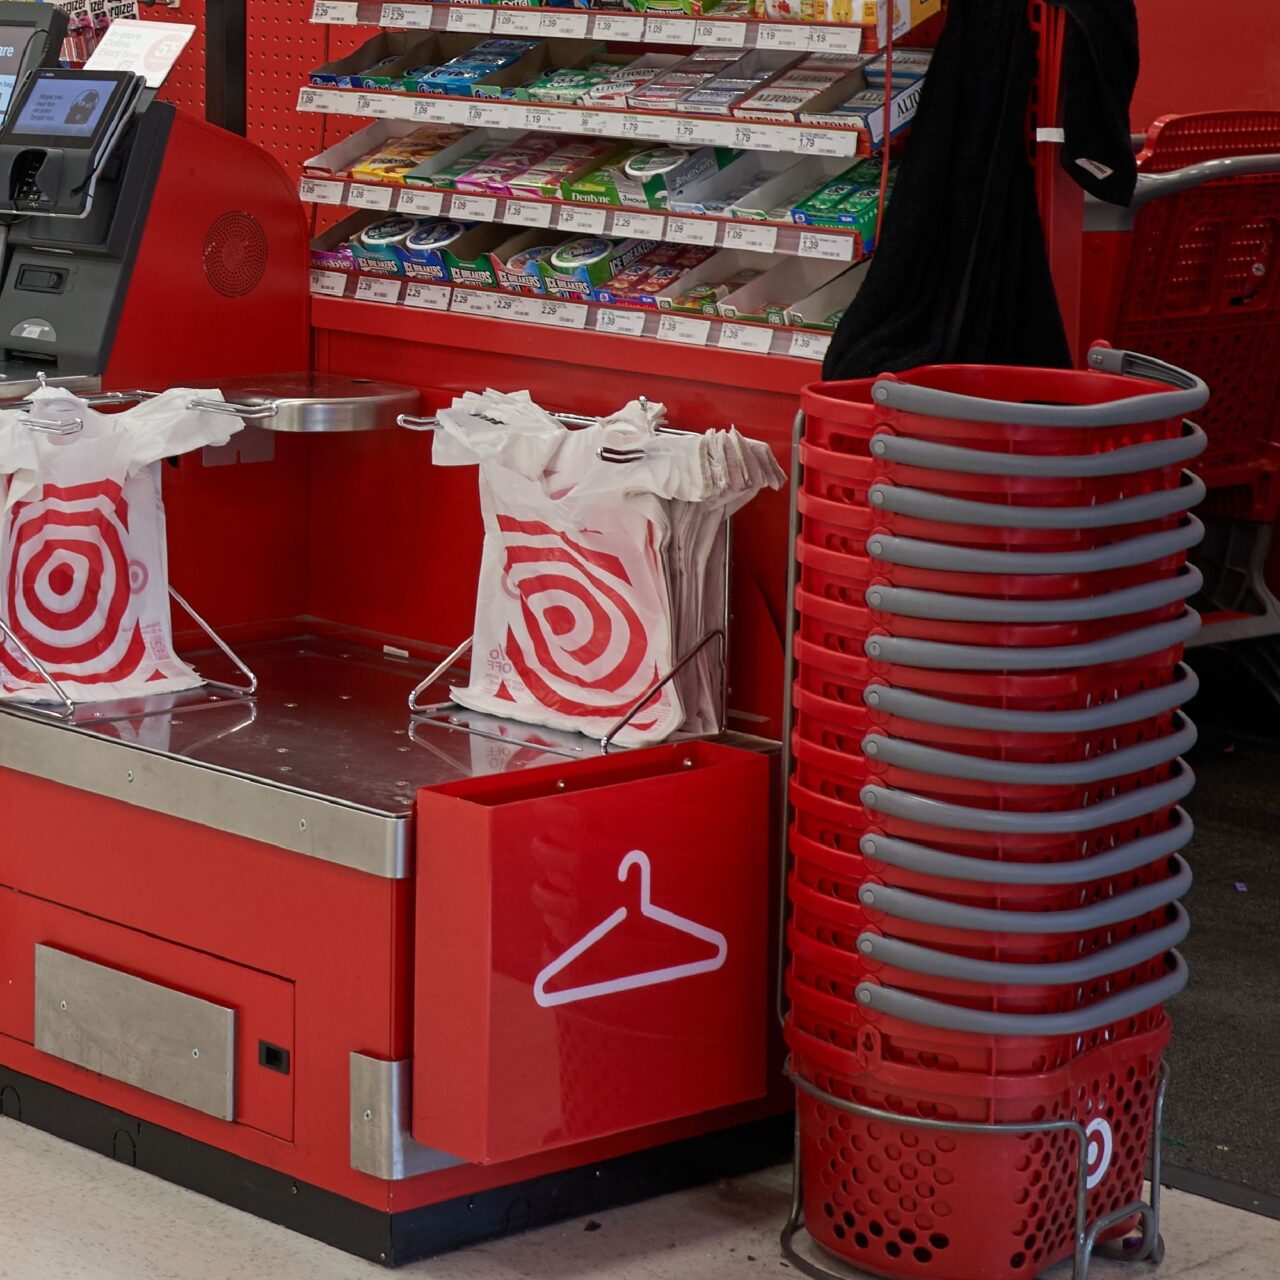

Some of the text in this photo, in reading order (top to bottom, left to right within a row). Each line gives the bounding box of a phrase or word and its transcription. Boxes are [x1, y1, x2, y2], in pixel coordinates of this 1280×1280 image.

[315, 8, 328, 17] 2.29
[390, 12, 404, 21] 2.29
[648, 24, 663, 34] 1.09
[696, 26, 713, 37] 1.09
[760, 31, 775, 40] 1.19
[301, 95, 314, 105] 1.09
[752, 93, 806, 104] ALTOIDS
[357, 100, 370, 109] 1.09
[414, 106, 428, 115] 1.09
[469, 111, 482, 120] 1.09
[525, 114, 541, 124] 1.19
[622, 122, 638, 132] 1.79
[677, 126, 694, 136] 1.79
[735, 133, 751, 142] 1.79
[799, 138, 815, 148] 1.79
[301, 185, 315, 194] 1.09
[350, 189, 364, 199] 1.09
[400, 195, 414, 204] 1.09
[571, 192, 611, 204] Dentyne
[452, 200, 467, 210] 1.09
[615, 219, 630, 227] 2.29
[669, 224, 684, 233] 1.09
[726, 230, 742, 239] 1.09
[802, 240, 819, 249] 1.39
[609, 240, 658, 275] ICE BREAKERS
[359, 257, 398, 273] ICE BREAKERS
[404, 261, 444, 278] ICE BREAKERS
[452, 267, 493, 283] ICE BREAKERS
[499, 271, 541, 288] ICE BREAKERS
[359, 282, 372, 291] 2.29
[545, 276, 590, 295] ICE BREAKERS
[407, 288, 421, 298] 2.29
[453, 295, 468, 304] 2.29
[497, 301, 512, 309] 2.29
[541, 306, 557, 315] 2.29
[722, 330, 738, 339] 1.39
[794, 338, 810, 348] 1.39
